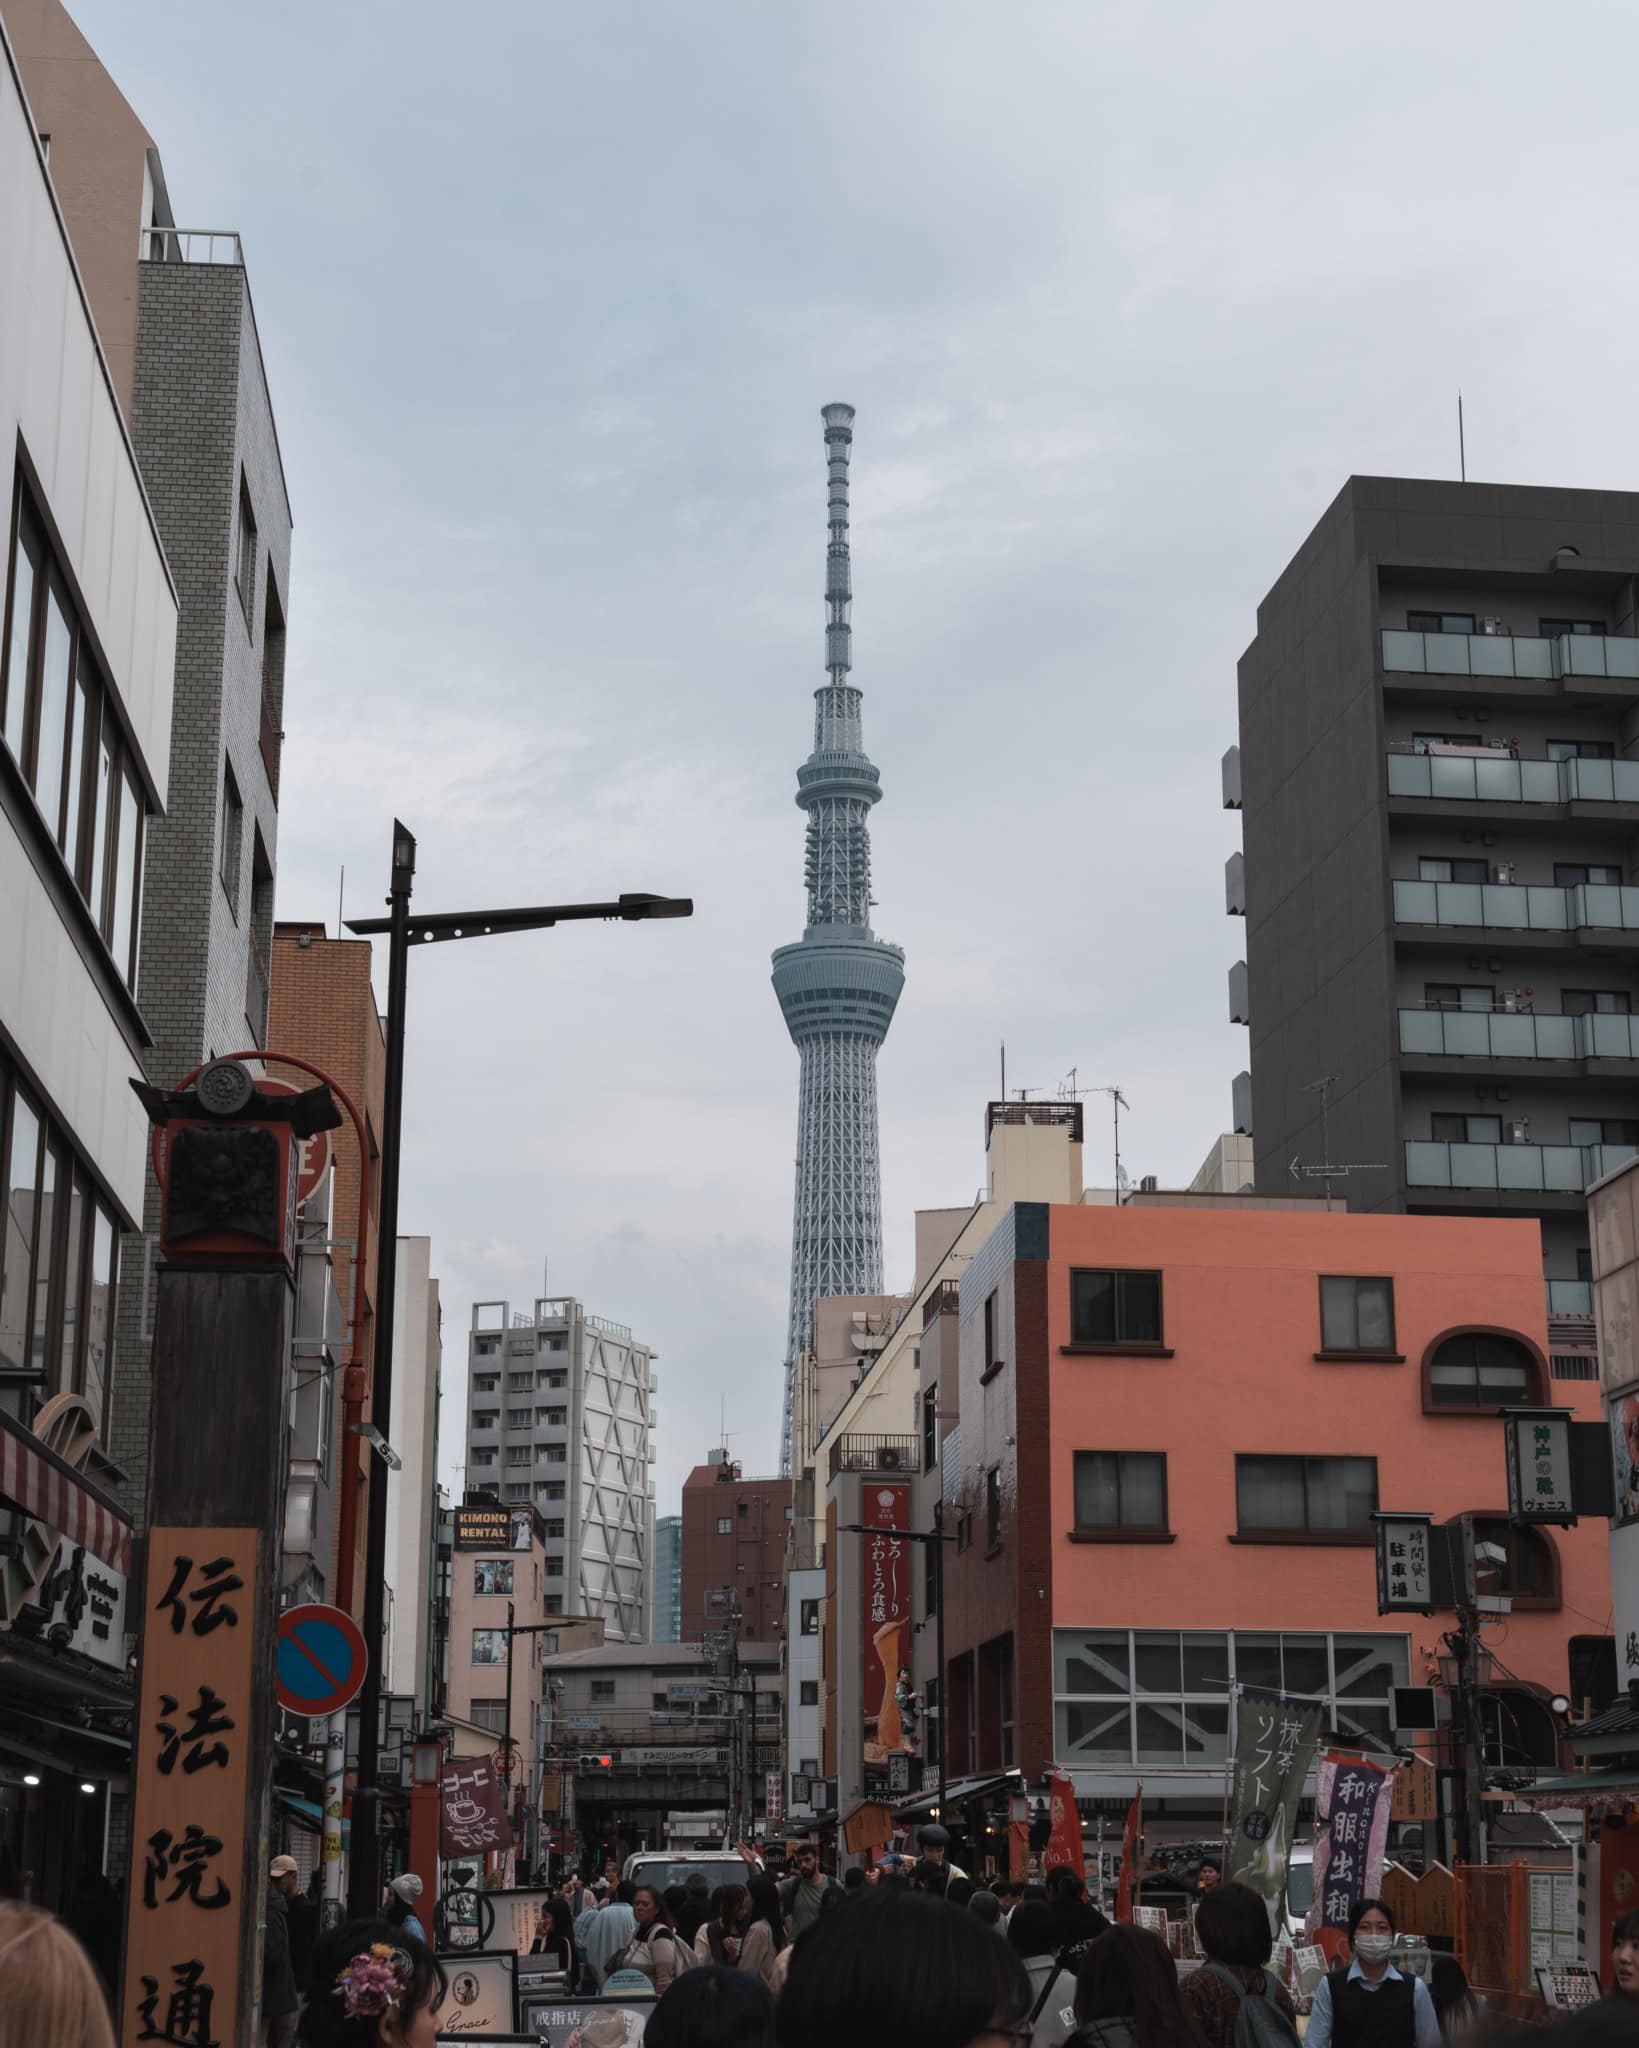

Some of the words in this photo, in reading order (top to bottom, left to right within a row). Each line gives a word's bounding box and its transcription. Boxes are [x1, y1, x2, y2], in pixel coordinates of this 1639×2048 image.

[459, 1513, 507, 1523] KIMONO
[460, 1527, 506, 1537] RENTAL
[1524, 1498, 1567, 1511] ヴェニス
[872, 1534, 886, 1622] ふわとろ食感
[1390, 1542, 1408, 1598] 駐車場
[1251, 1715, 1275, 1807] ソフト
[1277, 1717, 1304, 1776] 抹茶
[137, 1555, 244, 2048] 伝法院通
[1325, 1771, 1366, 1923] 和服出租
[535, 2009, 582, 2026] 戒指店
